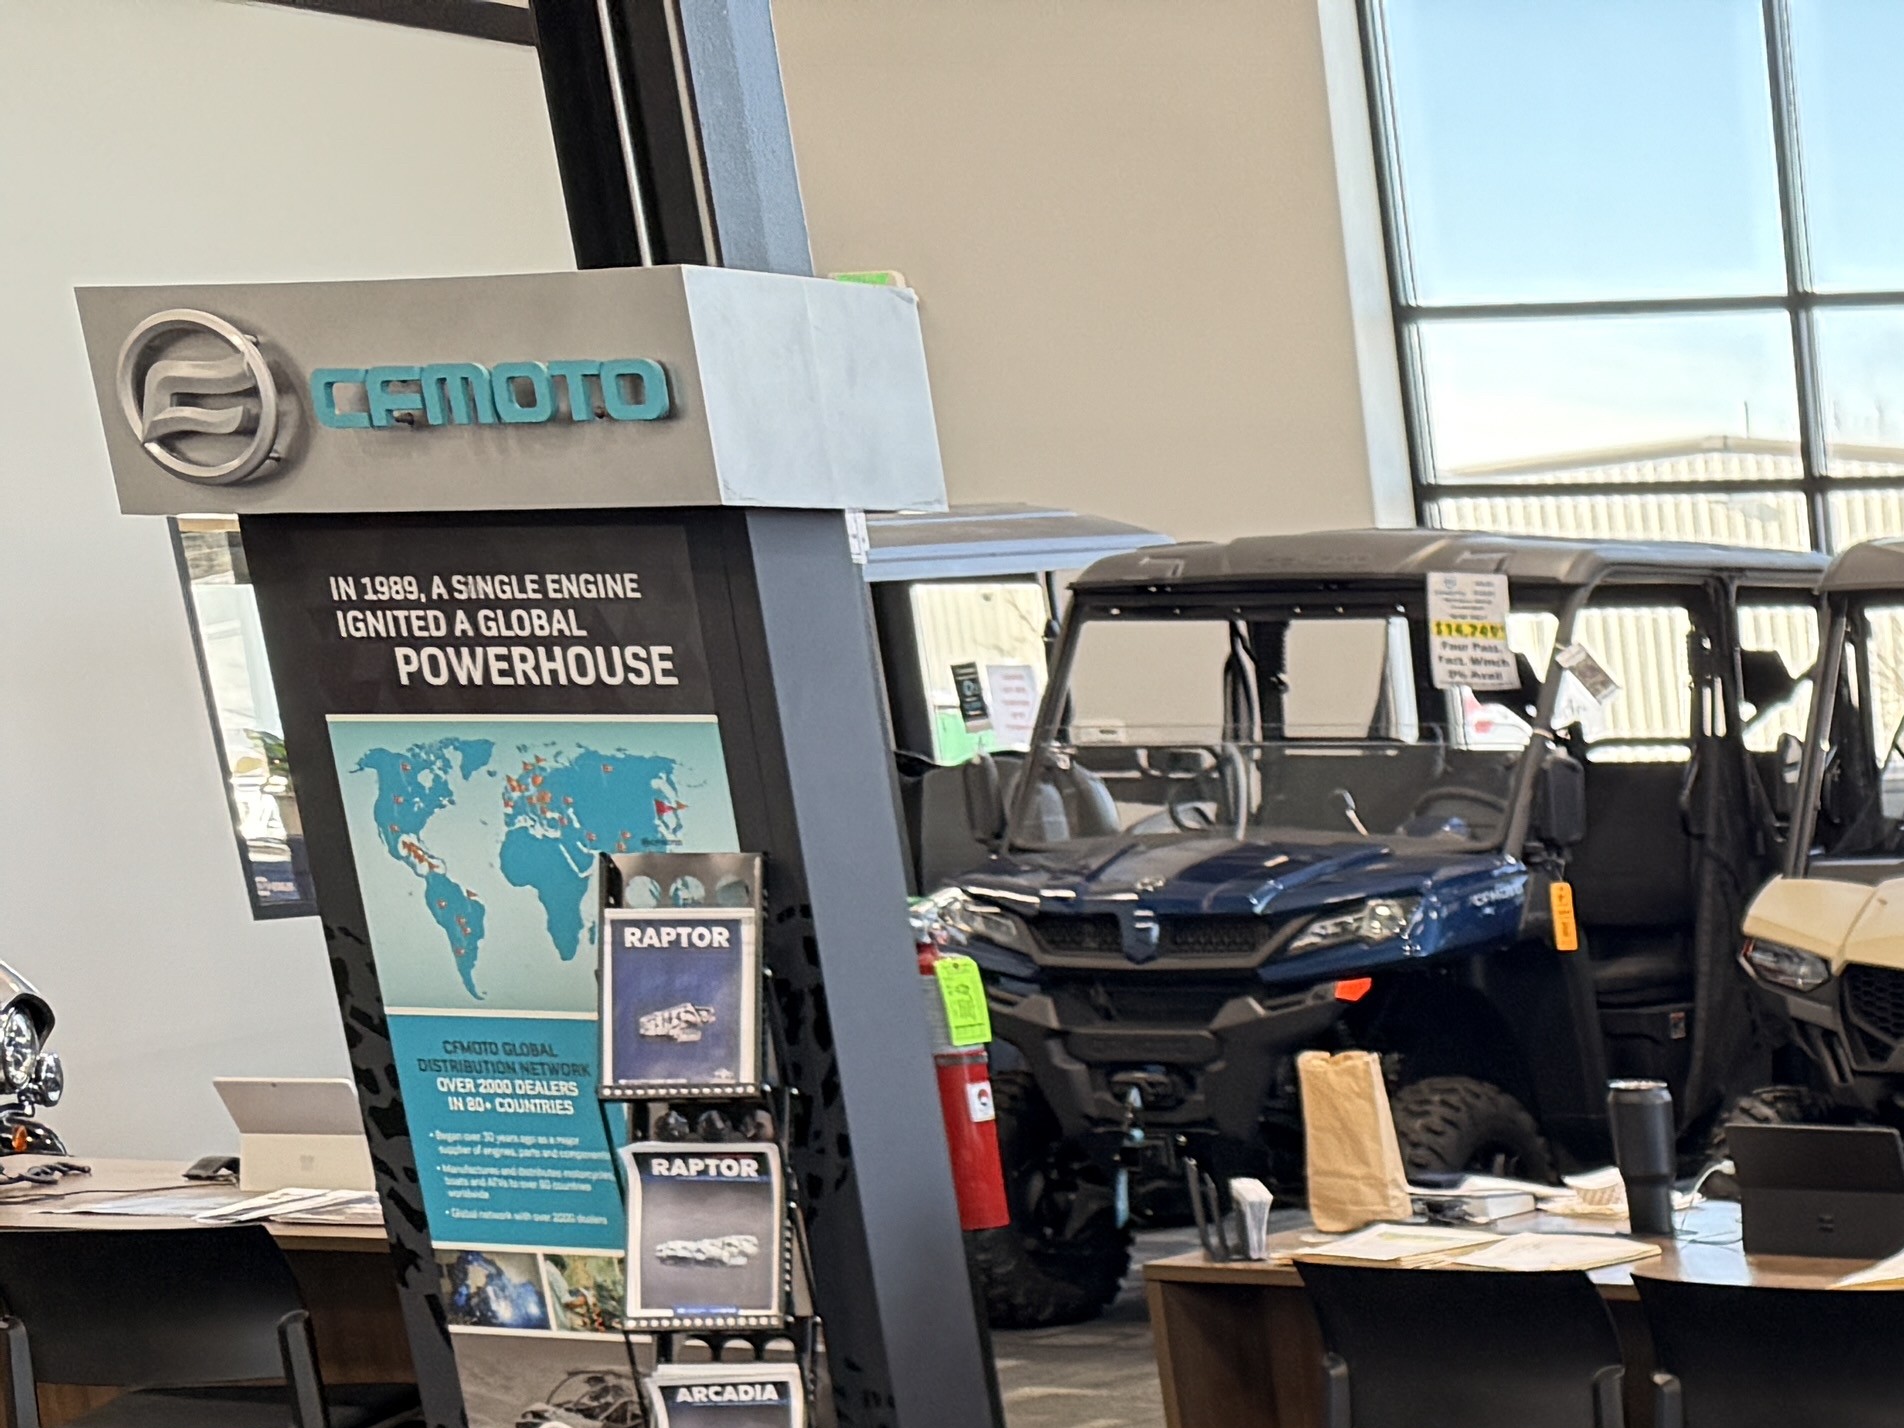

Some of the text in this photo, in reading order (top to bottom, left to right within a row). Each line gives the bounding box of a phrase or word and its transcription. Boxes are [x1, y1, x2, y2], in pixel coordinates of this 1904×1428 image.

[309, 358, 672, 429] CFMOTO
[330, 574, 641, 602] IN 1989, A SINGLE ENGINE
[337, 609, 587, 637] IGNITED A GLOBAL
[395, 646, 679, 686] POWERHOUSE
[624, 927, 730, 948] RAPTOR
[443, 1041, 558, 1057] CFMOTO GLOBAL
[417, 1058, 591, 1077] DISTRIBUTION NETWORK
[437, 1078, 579, 1096] OVER 2000 DEALERS
[448, 1097, 463, 1111] IN
[496, 1098, 574, 1115] COUNTRIES
[652, 1158, 759, 1177] RAPTOR
[676, 1385, 779, 1402] ARCADIA
